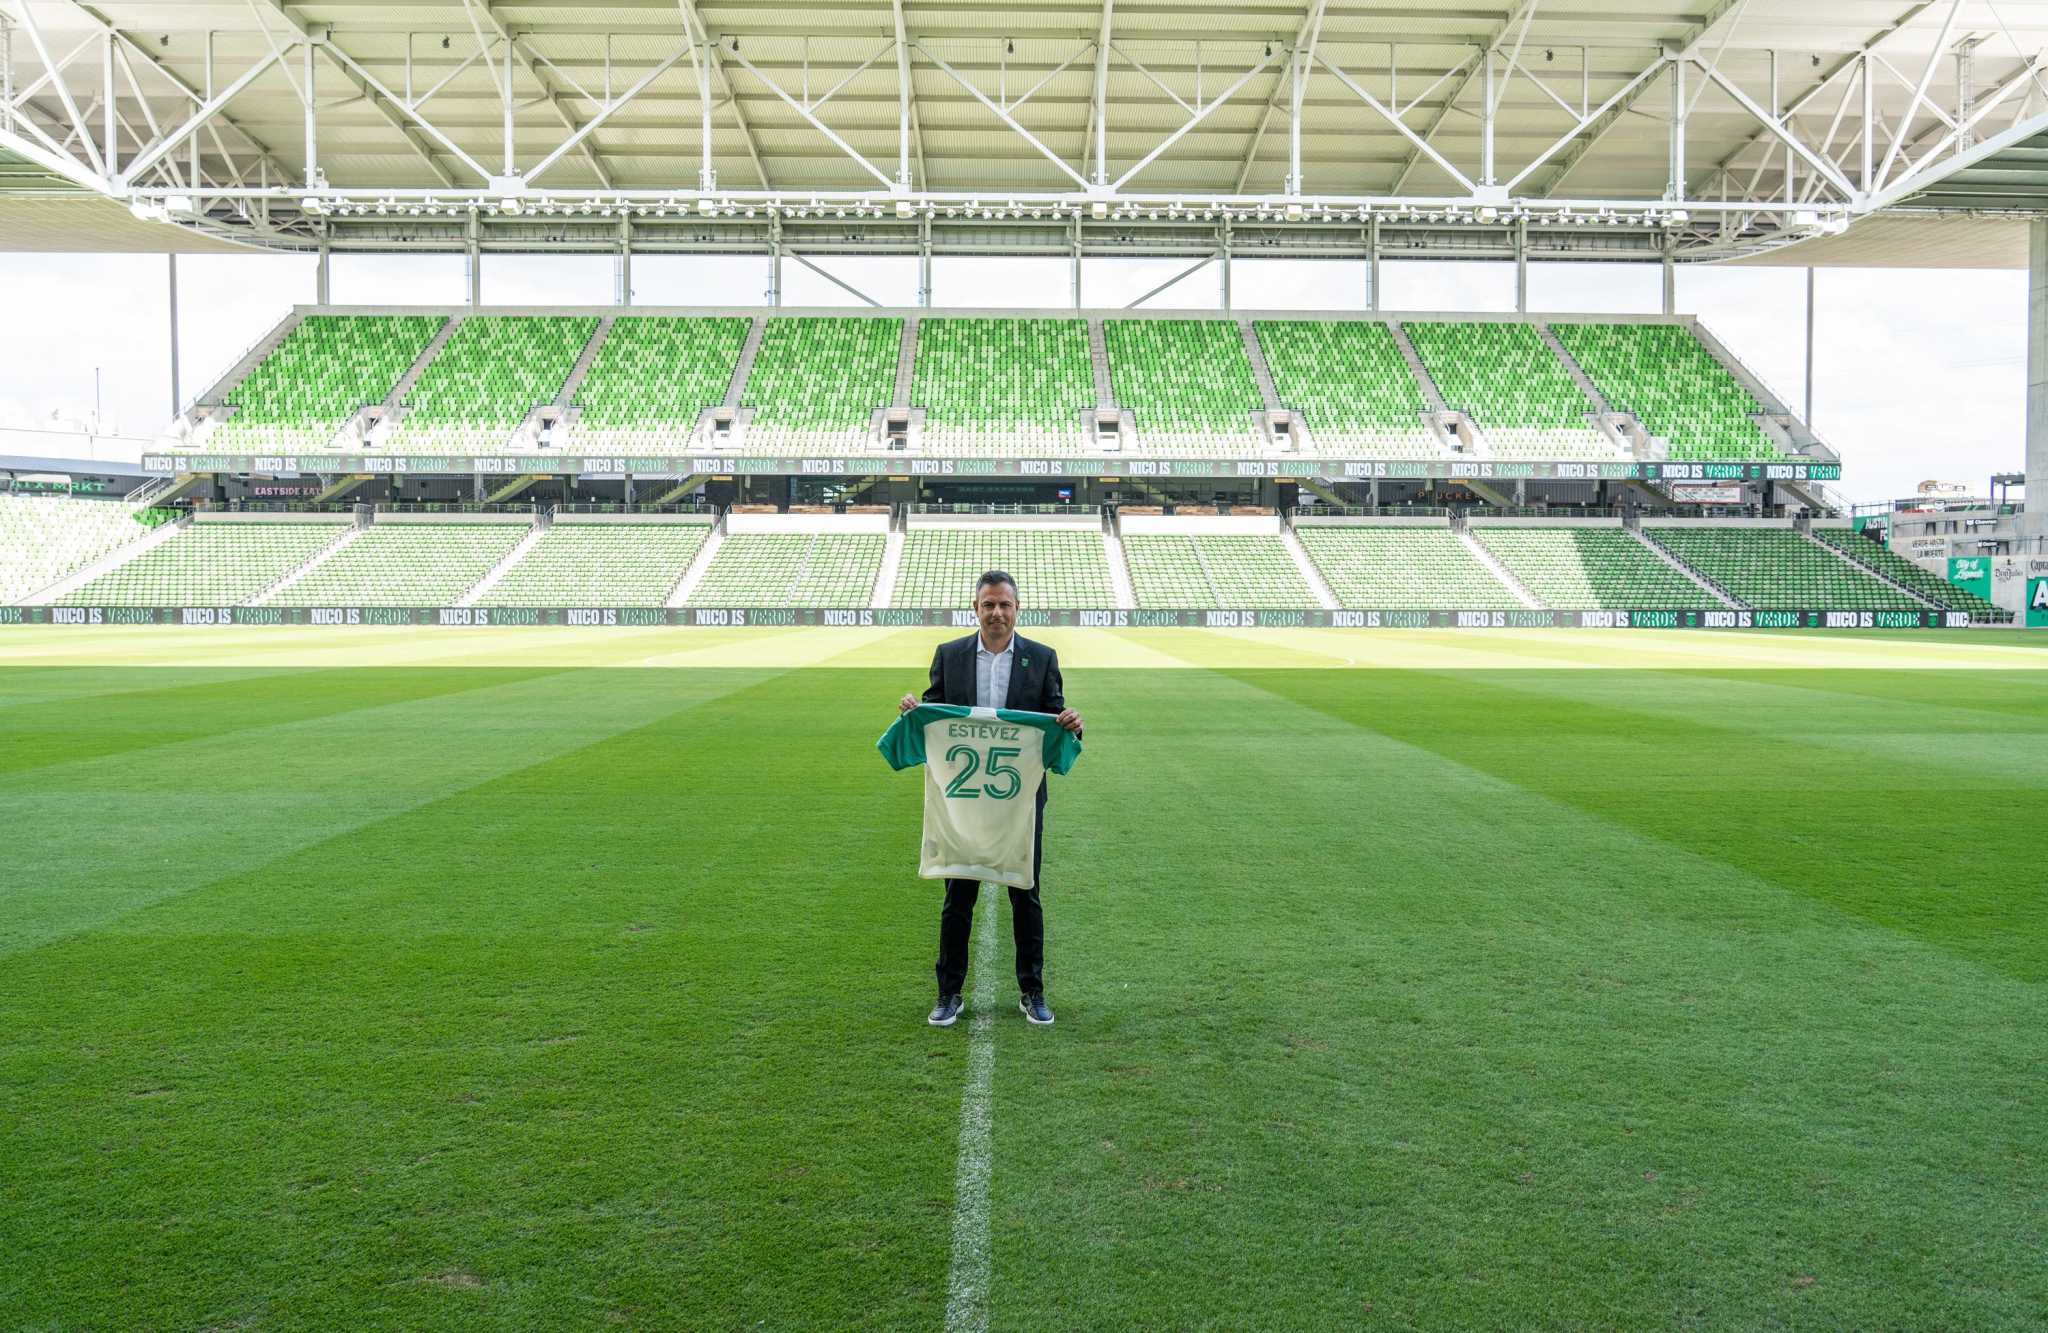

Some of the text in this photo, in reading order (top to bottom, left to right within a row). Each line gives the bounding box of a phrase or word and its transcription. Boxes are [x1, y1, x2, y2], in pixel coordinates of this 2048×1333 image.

[145, 457, 172, 471] NICO
[176, 457, 186, 471] IS
[255, 458, 283, 471] NICO
[286, 458, 296, 471] IS
[365, 458, 392, 472] NICO
[395, 458, 406, 472] IS
[474, 459, 501, 472] NICO
[505, 459, 515, 472] IS
[584, 459, 611, 473] NICO
[615, 459, 625, 473] IS
[693, 460, 720, 473] NICO
[724, 460, 734, 473] IS
[803, 460, 829, 474] NICO
[833, 460, 844, 474] IS
[912, 461, 939, 474] NICO
[942, 461, 953, 474] IS
[1021, 461, 1047, 475] NICO
[1051, 462, 1062, 475] IS
[1129, 462, 1155, 475] NICO
[1160, 462, 1170, 475] IS
[1238, 463, 1264, 475] NICO
[1267, 463, 1278, 476] IS
[1345, 463, 1371, 476] NICO
[1375, 463, 1385, 476] IS
[1452, 464, 1478, 476] NICO
[1481, 464, 1492, 477] IS
[1558, 464, 1583, 477] NICO
[1587, 464, 1597, 477] IS
[1663, 465, 1688, 477] NICO
[1692, 465, 1702, 477] IS
[1767, 465, 1792, 478] NICO
[1796, 465, 1806, 478] IS
[255, 487, 301, 495] EASTSIDE
[53, 608, 85, 623] NICO
[89, 608, 102, 623] IS
[182, 608, 214, 624] NICO
[218, 608, 231, 624] IS
[311, 609, 342, 624] NICO
[347, 609, 359, 624] IS
[440, 609, 471, 624] NICO
[475, 609, 488, 624] IS
[568, 609, 599, 624] NICO
[603, 609, 616, 624] IS
[696, 609, 727, 625] NICO
[732, 609, 744, 625] IS
[824, 610, 856, 625] NICO
[860, 610, 872, 625] IS
[952, 610, 980, 625] NIC
[1080, 610, 1111, 625] NICO
[1115, 610, 1127, 625] IS
[1207, 610, 1237, 626] NICO
[1242, 610, 1254, 626] IS
[1333, 611, 1364, 626] NICO
[1368, 611, 1380, 626] IS
[1458, 611, 1489, 626] NICO
[1492, 611, 1505, 626] IS
[1582, 611, 1612, 626] NICO
[1616, 611, 1629, 626] IS
[1705, 611, 1735, 627] NICO
[1739, 611, 1751, 627] IS
[1827, 612, 1856, 627] NICO
[1860, 612, 1873, 627] IS
[945, 744, 1021, 800] 25
